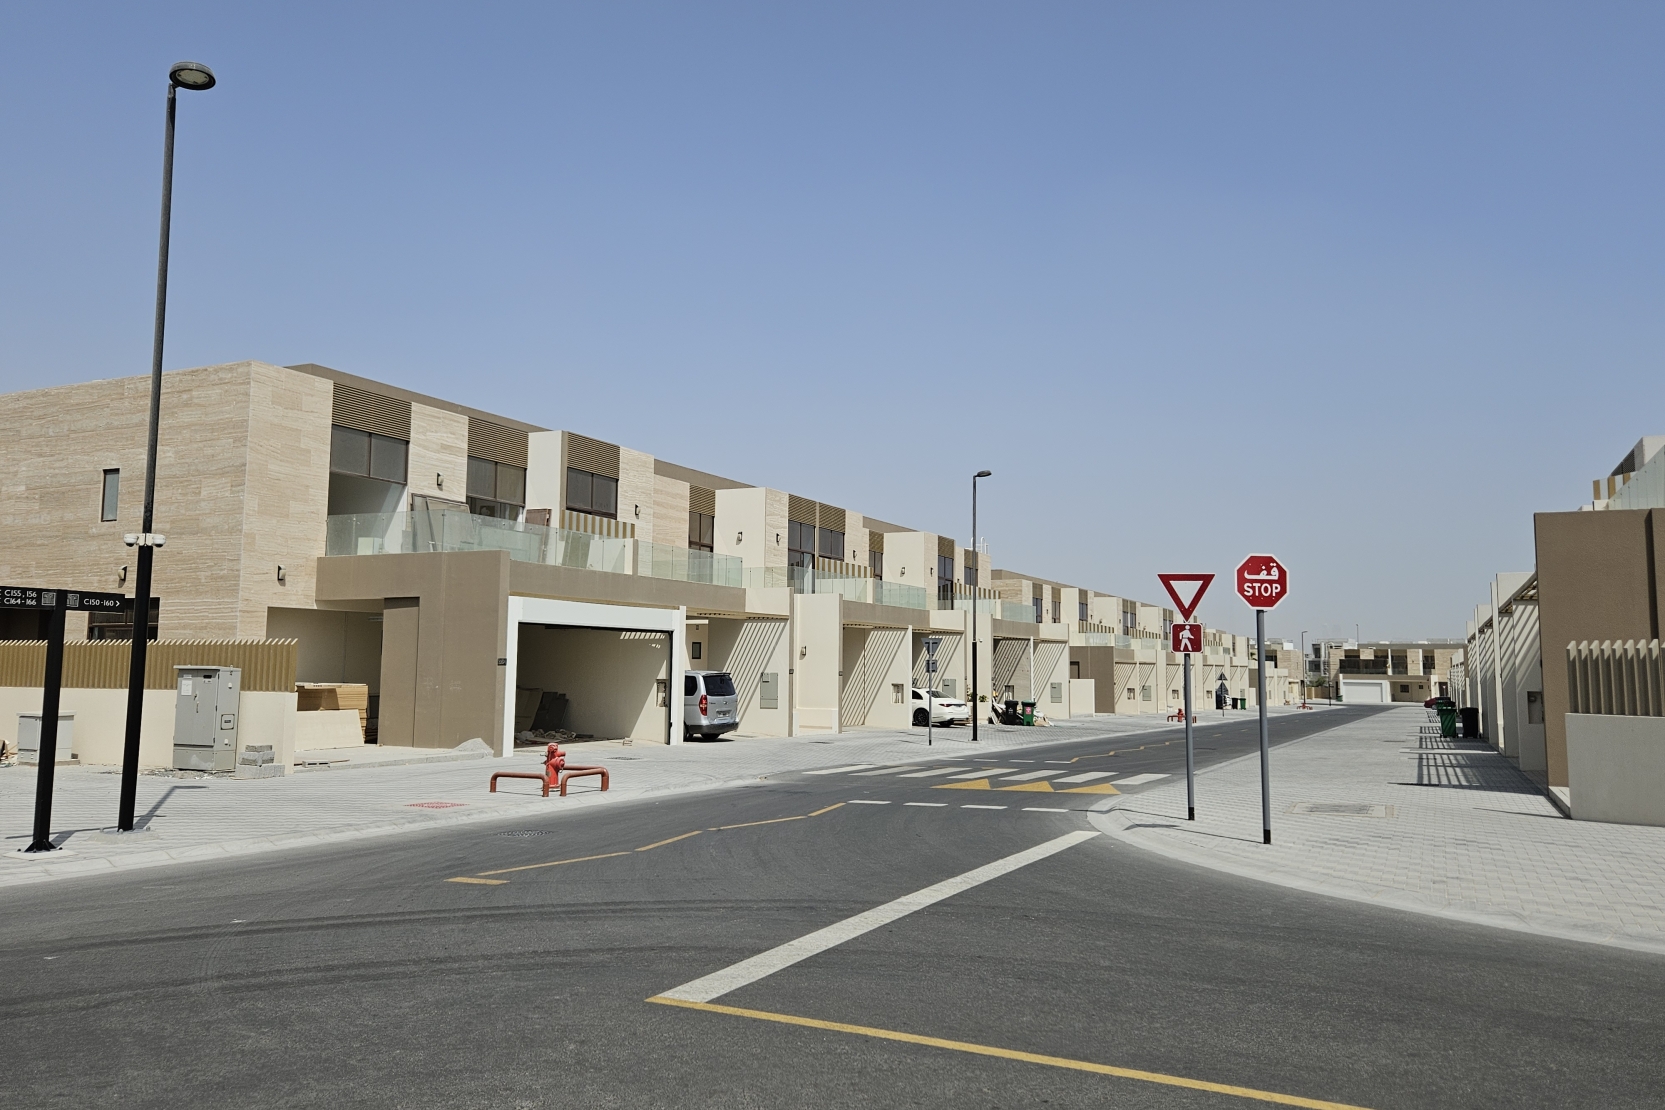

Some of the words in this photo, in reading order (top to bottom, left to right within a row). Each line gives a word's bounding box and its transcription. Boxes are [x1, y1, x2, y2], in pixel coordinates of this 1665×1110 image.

[1244, 562, 1279, 580] قف
[26, 590, 37, 598] 156
[1243, 582, 1281, 597] STOP
